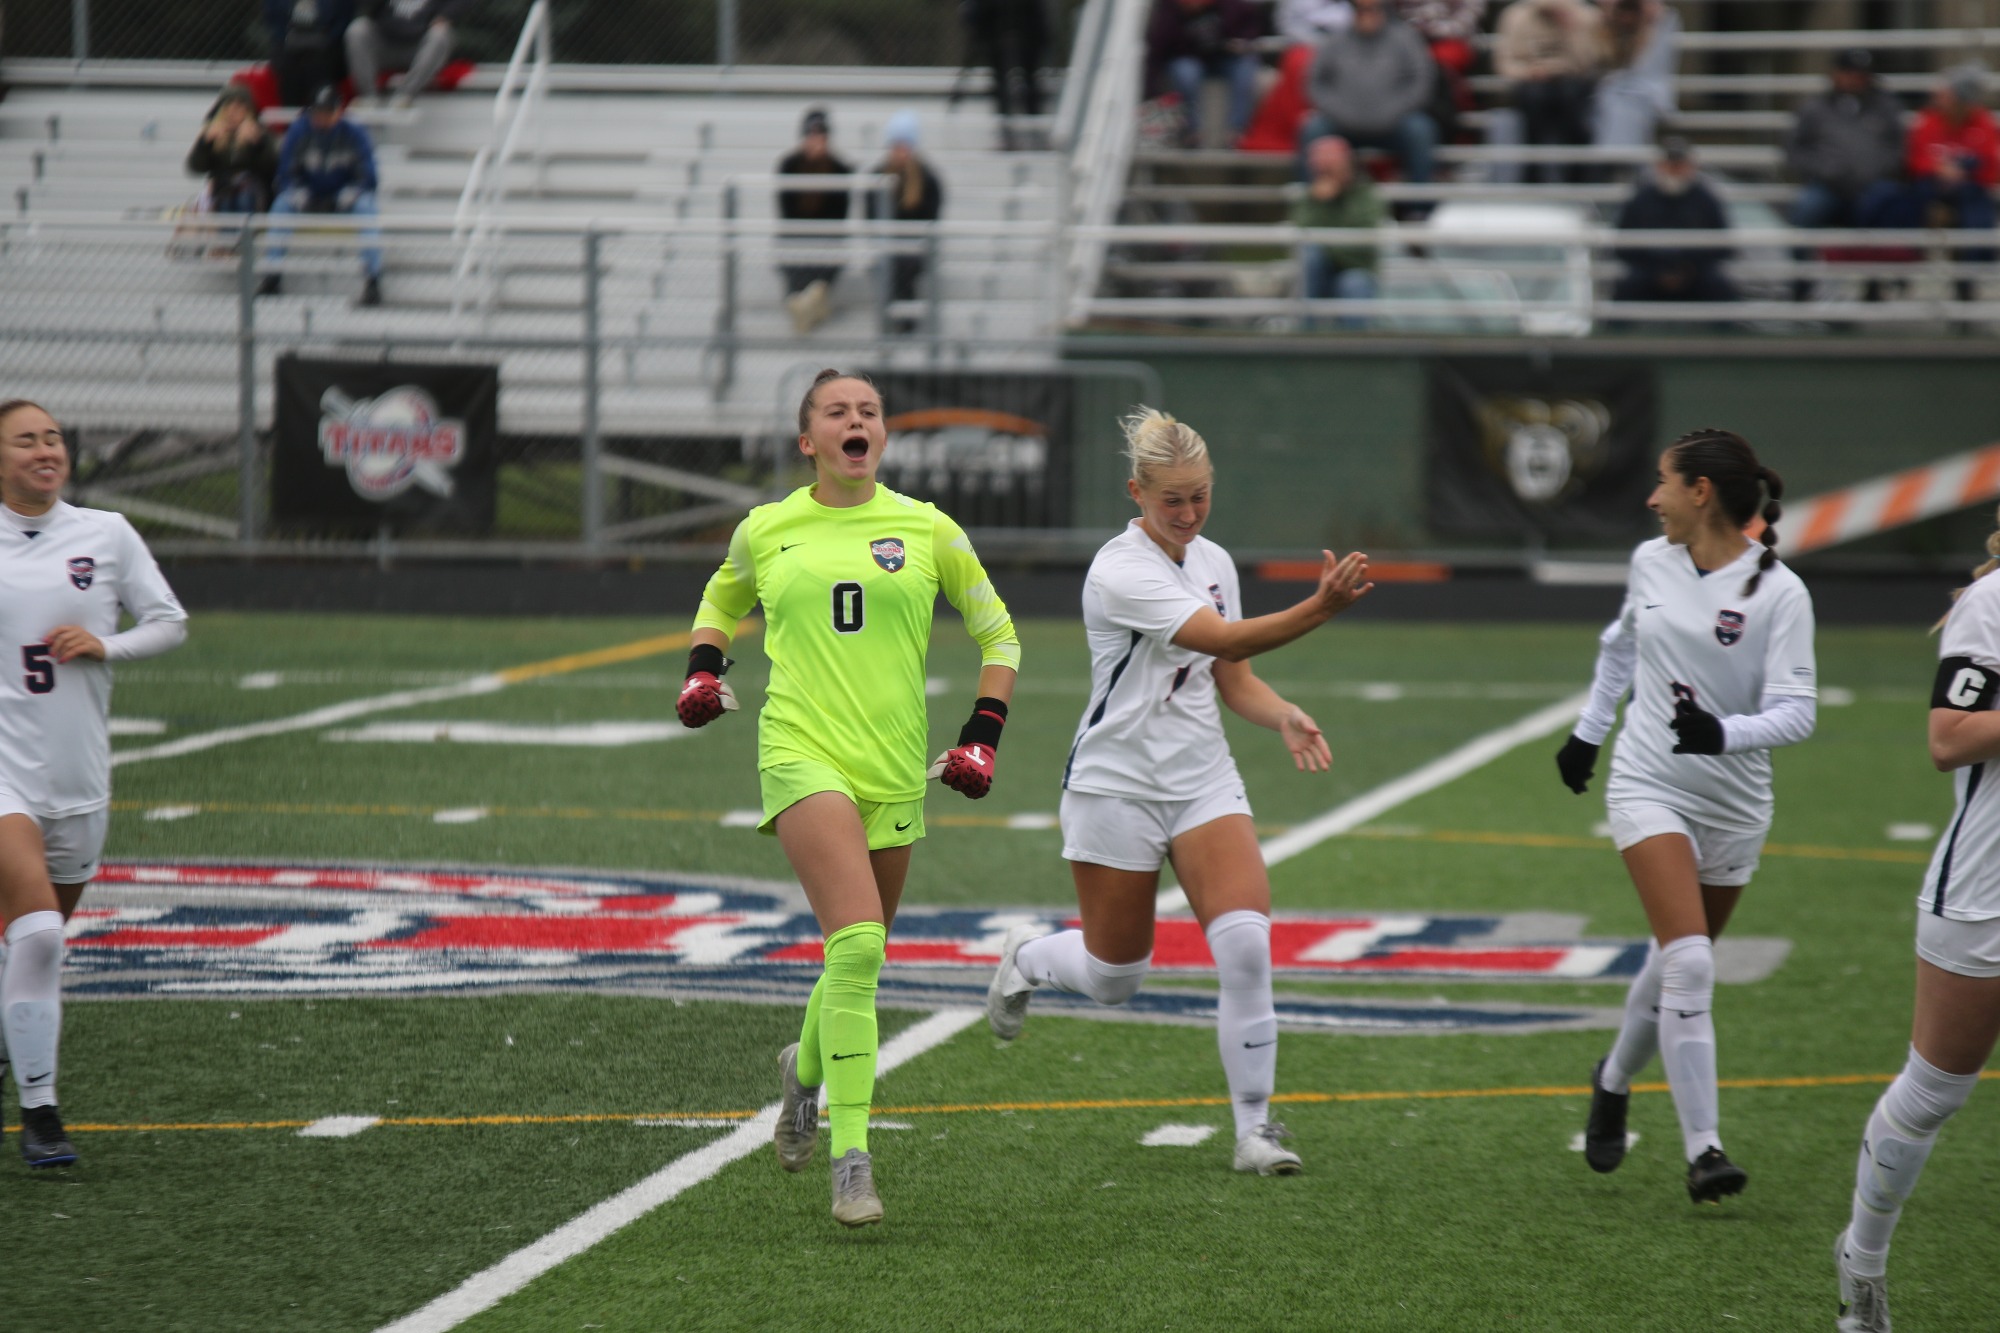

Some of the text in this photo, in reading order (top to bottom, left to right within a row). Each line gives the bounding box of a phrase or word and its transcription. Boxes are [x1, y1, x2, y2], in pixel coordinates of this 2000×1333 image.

[321, 420, 460, 462] TITANS
[832, 581, 865, 634] 0
[21, 643, 55, 694] 5
[1946, 667, 1987, 708] C
